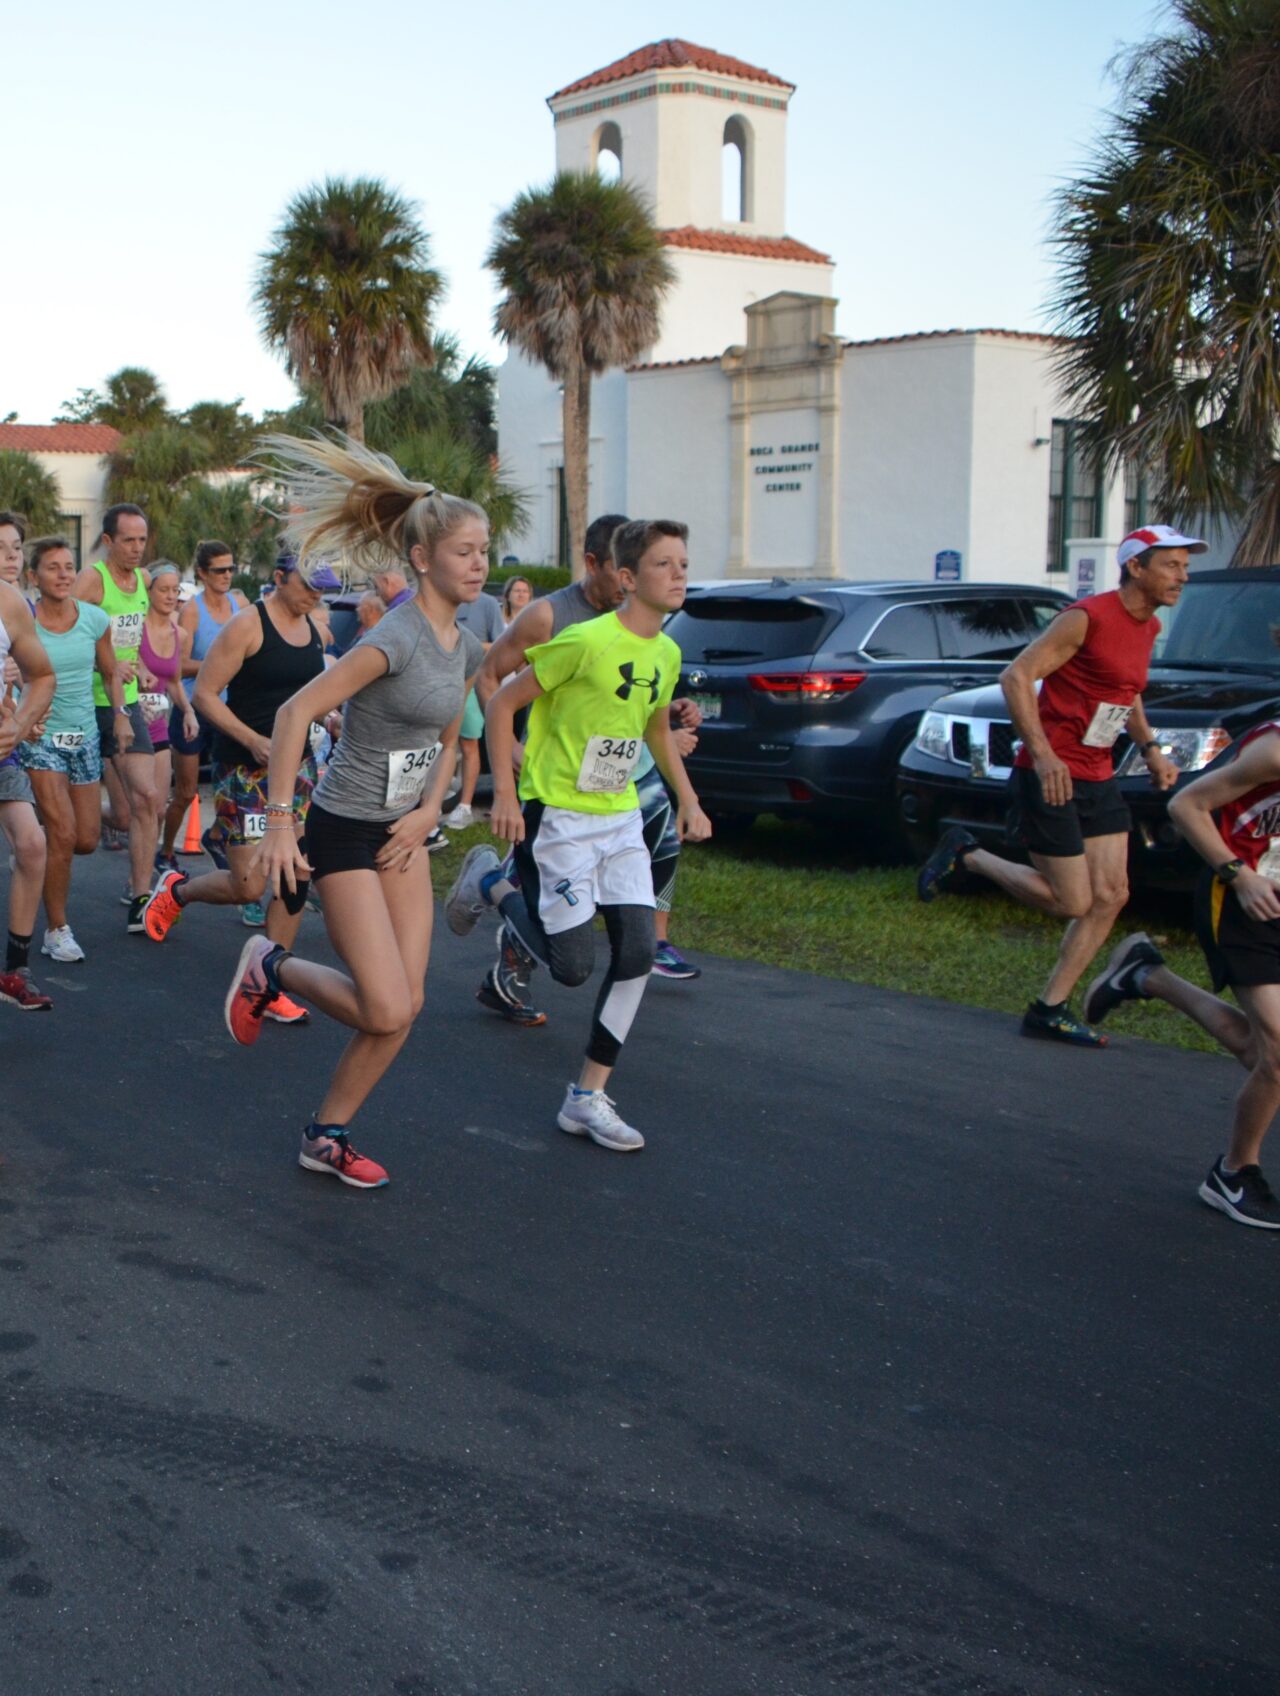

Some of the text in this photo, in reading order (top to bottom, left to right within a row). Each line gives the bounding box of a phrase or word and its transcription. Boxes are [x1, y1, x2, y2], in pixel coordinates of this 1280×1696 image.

[750, 442, 820, 456] BOCA GRANDE
[755, 463, 813, 475] COMMUNITY
[766, 483, 801, 493] CENTER
[117, 614, 139, 627] 320
[56, 734, 84, 746] 132
[598, 739, 637, 759] 348
[248, 816, 267, 832] 16
